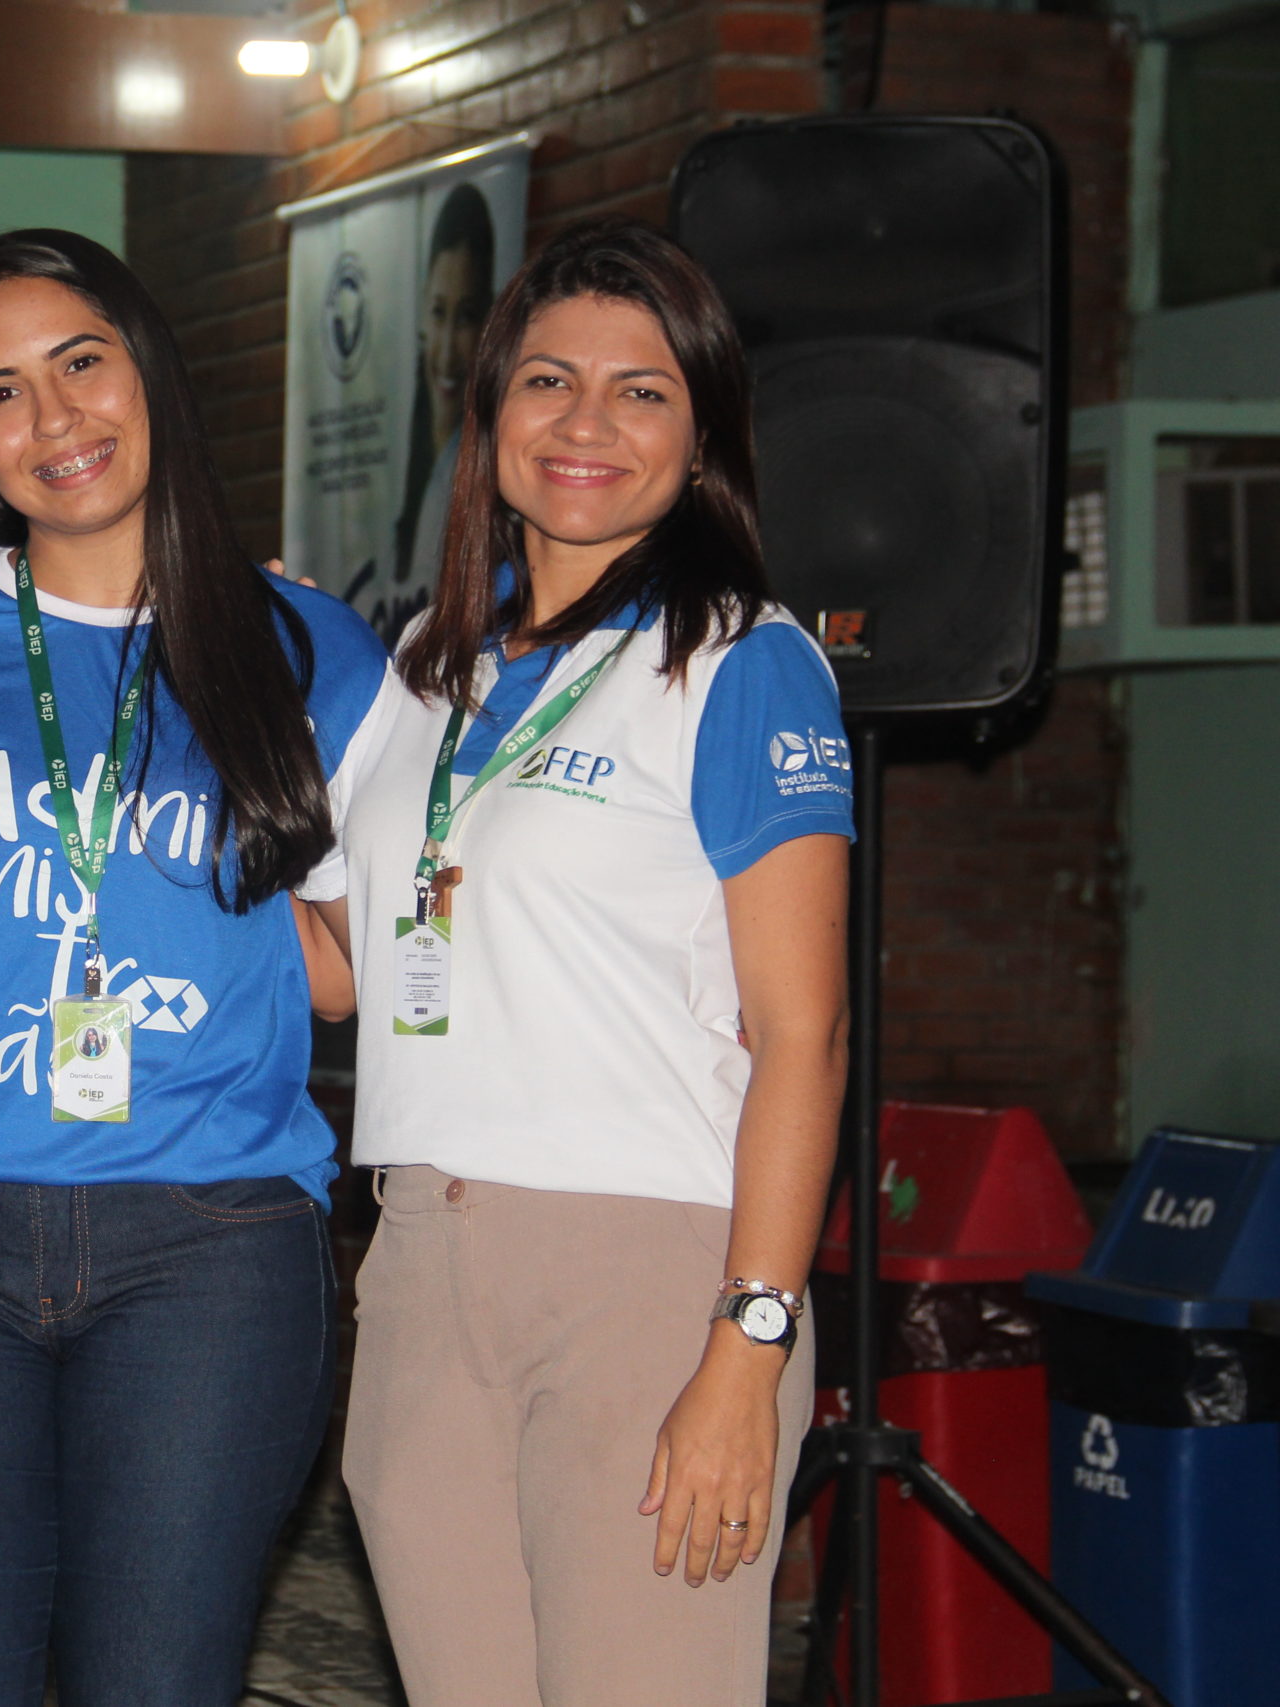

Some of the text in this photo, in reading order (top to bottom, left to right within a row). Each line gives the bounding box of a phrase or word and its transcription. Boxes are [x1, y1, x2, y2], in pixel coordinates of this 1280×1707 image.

[543, 746, 616, 786] FEP
[544, 782, 581, 797] Educação
[581, 791, 606, 803] Portal
[1073, 1466, 1131, 1500] PAPEL
